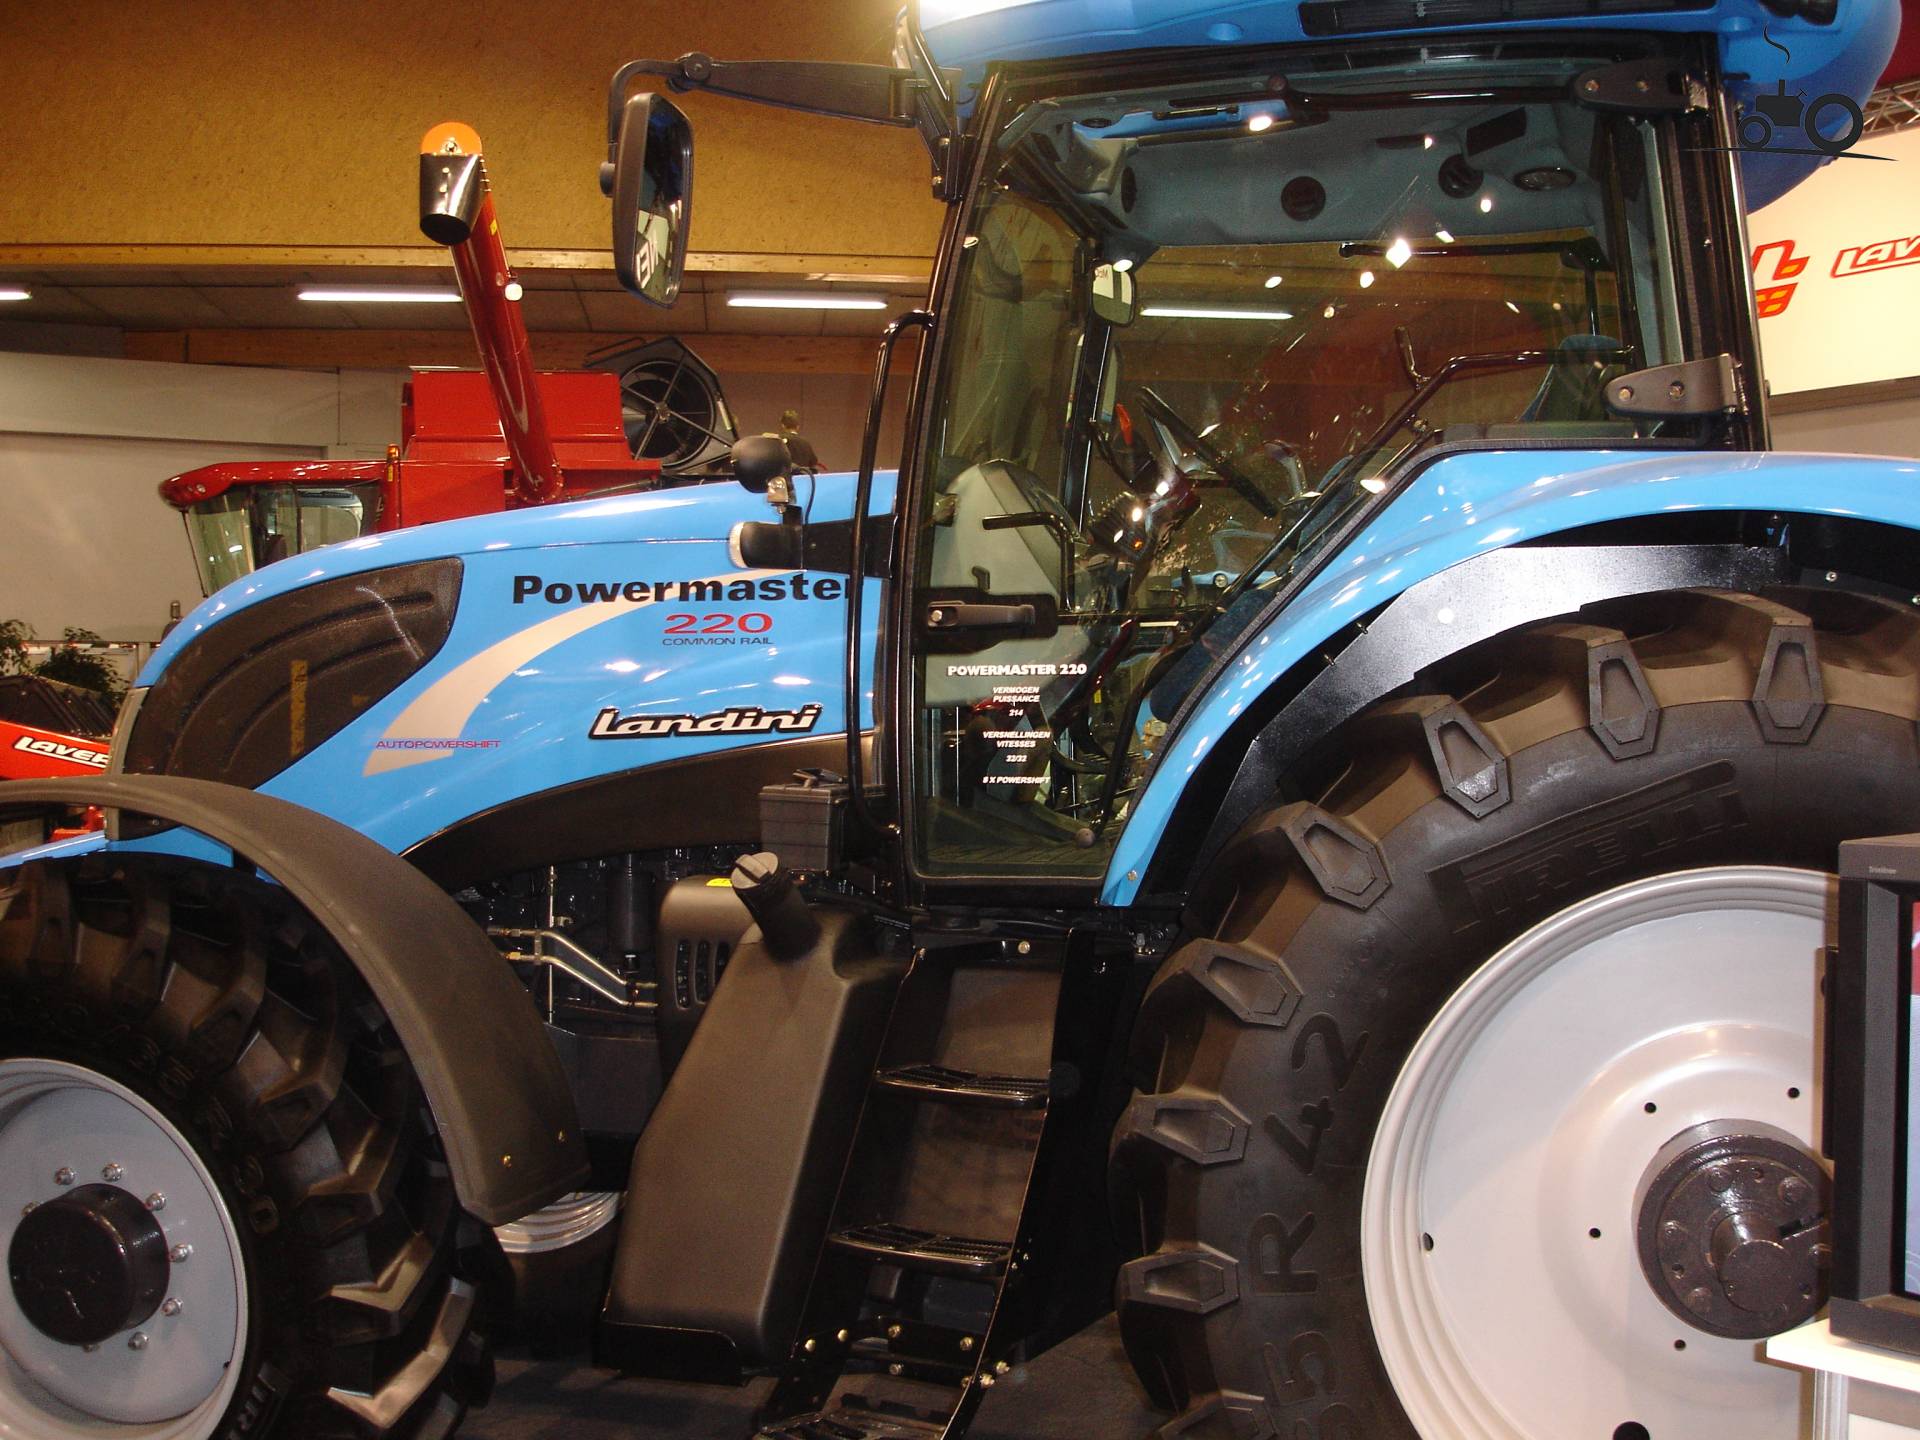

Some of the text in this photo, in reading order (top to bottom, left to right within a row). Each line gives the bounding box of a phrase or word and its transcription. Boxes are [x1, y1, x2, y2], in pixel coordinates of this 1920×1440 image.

[664, 612, 773, 634] 220
[662, 636, 775, 646] COMMON RAIL
[947, 663, 1087, 676] POWERMASTER 220
[992, 686, 1040, 694] VERMOGEN
[992, 694, 1041, 703] PUISSANCE
[1008, 708, 1024, 717] 214
[590, 705, 823, 739] Landini
[982, 731, 1051, 739] VERSNELLINGEN
[375, 740, 501, 749] AUTOPOWERSHIFT
[996, 740, 1036, 748] VITESSES
[989, 776, 996, 784] X
[996, 776, 1051, 784] POWERSHIFT
